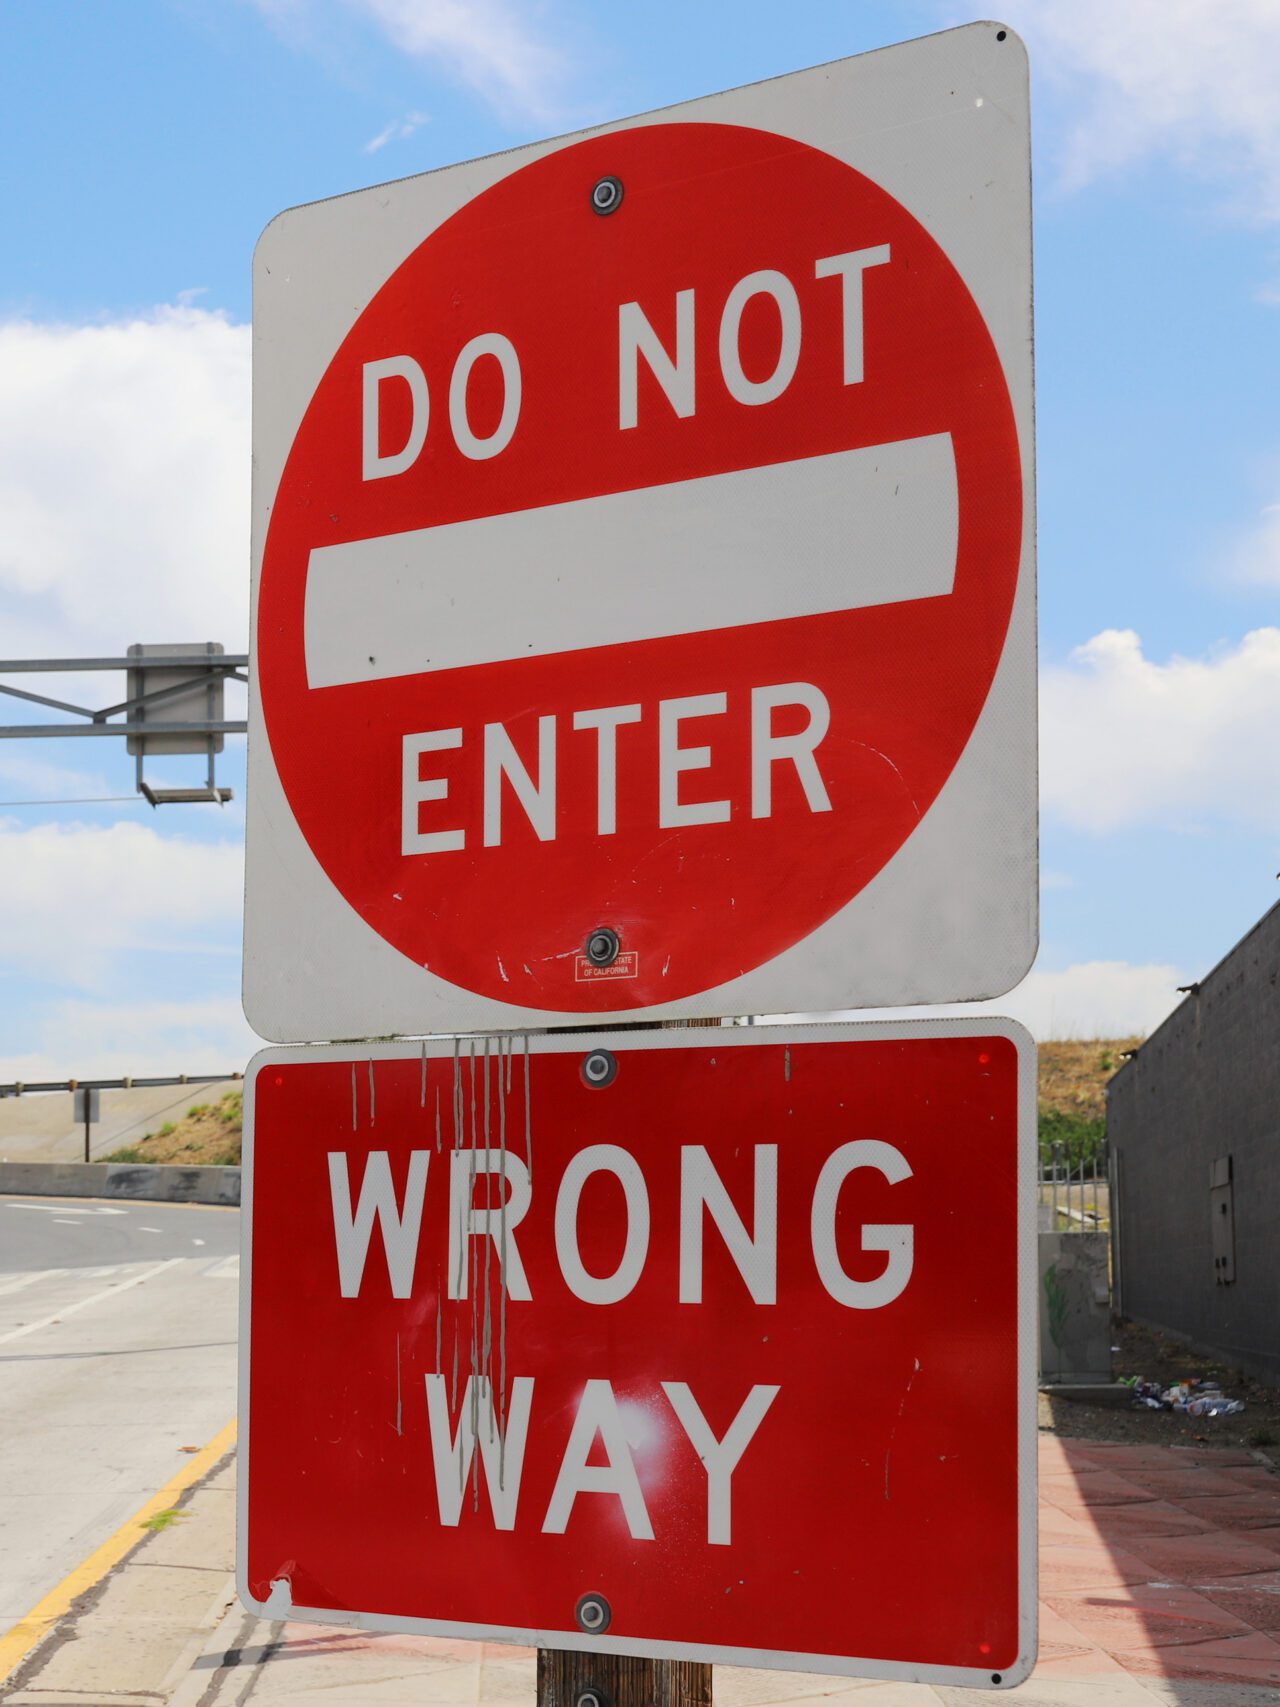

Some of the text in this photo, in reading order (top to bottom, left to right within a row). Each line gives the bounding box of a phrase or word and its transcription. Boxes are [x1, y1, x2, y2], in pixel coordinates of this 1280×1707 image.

[363, 244, 890, 481] DO NOT
[402, 682, 832, 855] ENTER
[584, 966, 628, 977] OF CALIFORNIA
[328, 1140, 913, 1309] WRONG
[425, 1372, 780, 1545] WAY
